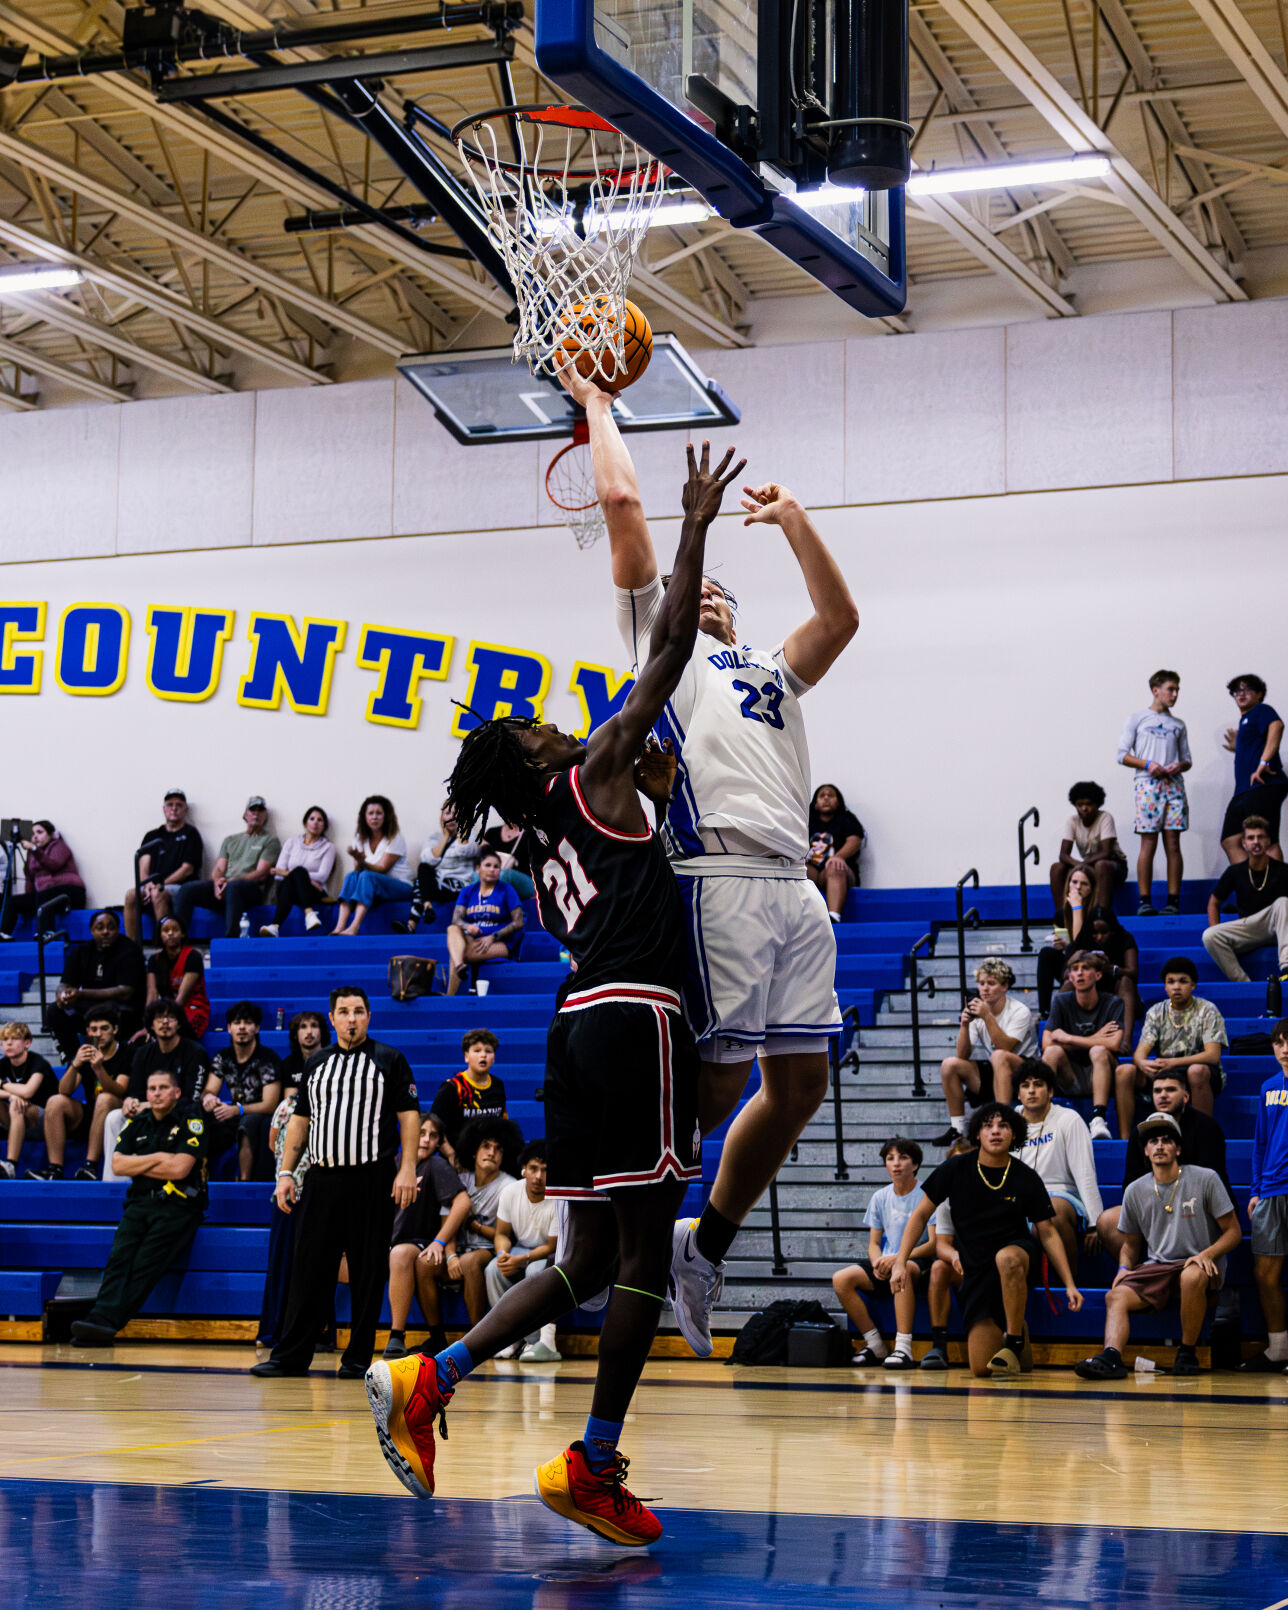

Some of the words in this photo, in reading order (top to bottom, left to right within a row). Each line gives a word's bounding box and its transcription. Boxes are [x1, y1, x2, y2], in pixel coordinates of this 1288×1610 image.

[732, 679, 785, 730] 23
[541, 835, 599, 934] 21
[1024, 1132, 1054, 1147] ENNIS
